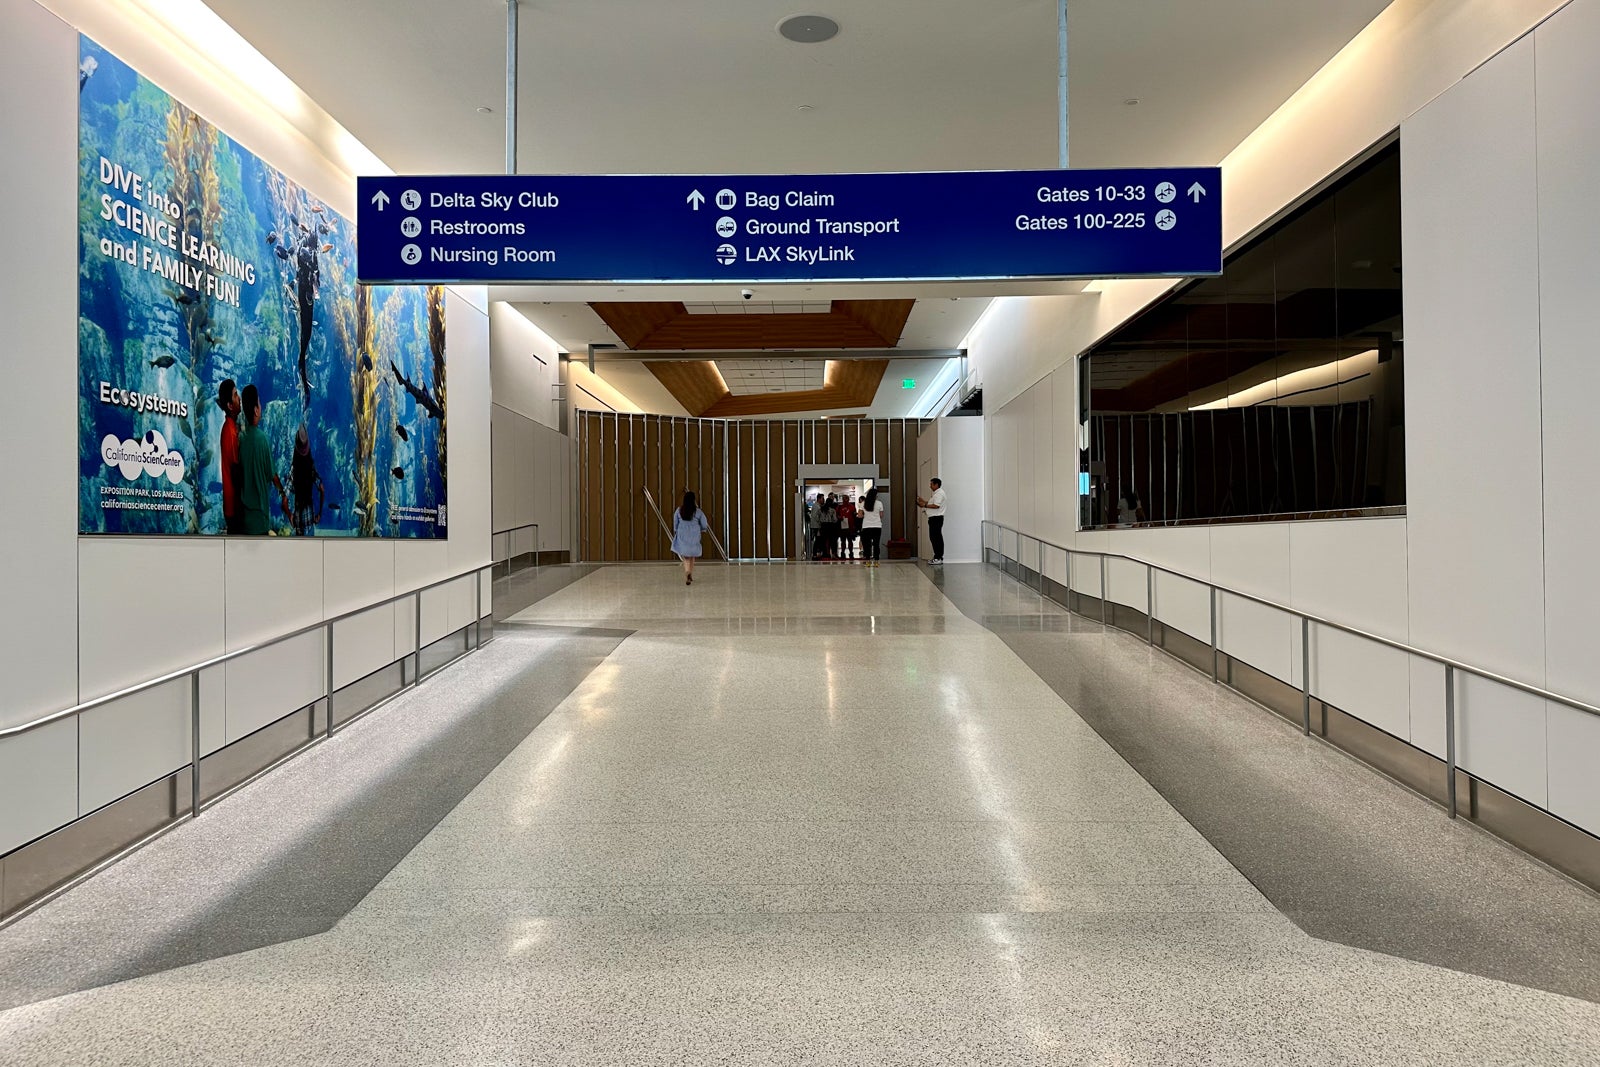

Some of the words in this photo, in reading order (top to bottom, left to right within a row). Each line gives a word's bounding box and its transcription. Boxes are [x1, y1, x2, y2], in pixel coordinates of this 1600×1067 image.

[100, 156, 142, 200] DIVE
[147, 181, 181, 219] into
[1037, 187, 1089, 202] Gates
[1095, 185, 1146, 201] 10-33
[430, 192, 476, 208] Delta
[480, 192, 513, 211] Sky
[518, 192, 559, 208] Club
[745, 191, 779, 210] Bag
[785, 191, 835, 207] Claim
[430, 219, 525, 235] Restrooms
[746, 219, 810, 234] Ground
[816, 218, 900, 236] Transport
[1015, 214, 1068, 230] Gates
[1073, 213, 1146, 229] 100-225
[100, 193, 177, 250] SCIENCE
[181, 230, 256, 285] LEARNING
[430, 247, 498, 265] Nursing
[504, 247, 556, 262] Room
[745, 246, 781, 262] LAX
[786, 246, 855, 265] SkyLink
[100, 237, 137, 267] and
[143, 245, 203, 292] FAMILY
[206, 273, 240, 308] FUN!
[100, 381, 188, 417] Ecosystems
[100, 486, 134, 496] EXPOSITION
[135, 488, 151, 498] PARK,
[152, 489, 162, 498] LOS
[162, 490, 184, 499] ANGELES
[100, 498, 184, 513] californiasciencecenter.org
